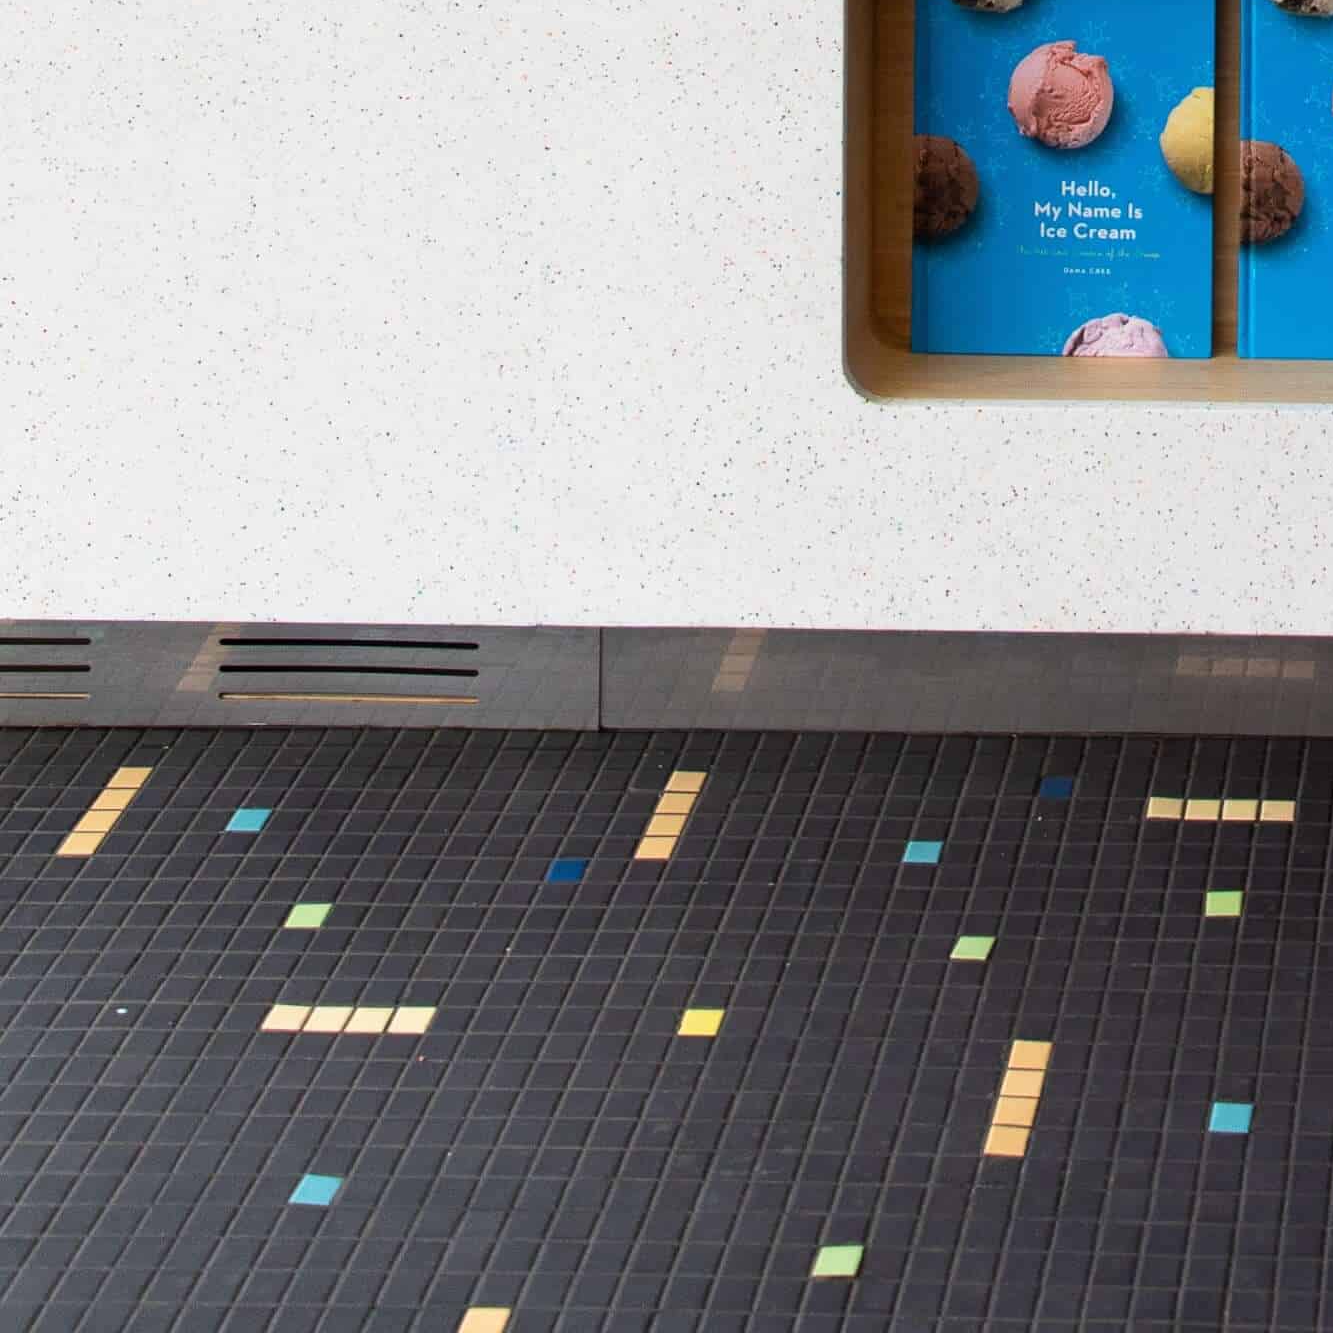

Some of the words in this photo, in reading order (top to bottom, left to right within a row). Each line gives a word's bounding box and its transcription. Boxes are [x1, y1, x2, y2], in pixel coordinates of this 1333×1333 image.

[1061, 180, 1117, 200] Hello,
[1034, 201, 1062, 222] My
[1068, 201, 1122, 219] Name
[1127, 202, 1144, 220] Is
[1040, 222, 1068, 238] Ice
[1073, 222, 1137, 241] Cream
